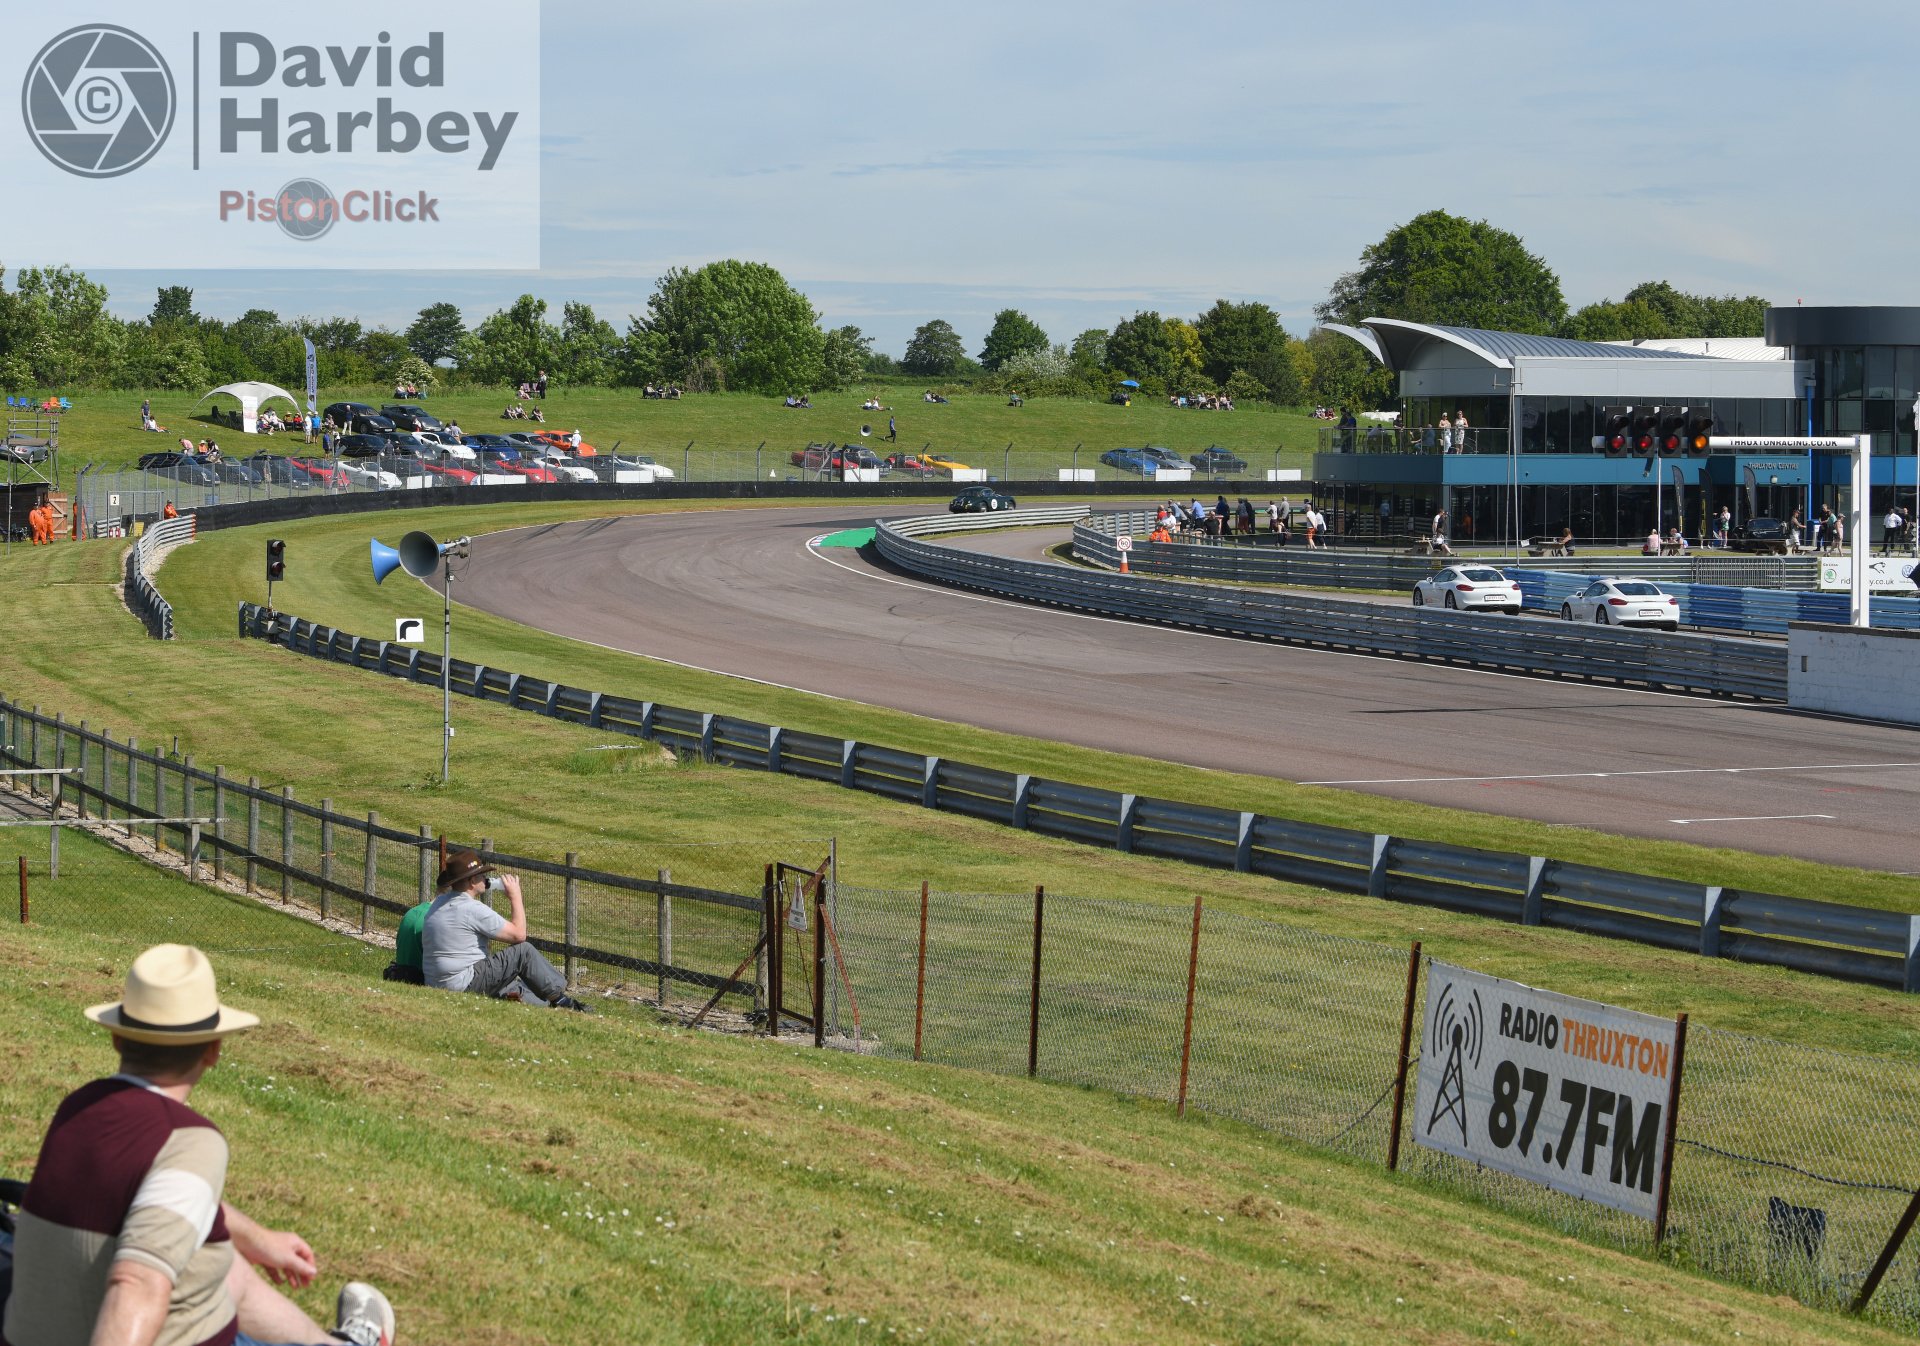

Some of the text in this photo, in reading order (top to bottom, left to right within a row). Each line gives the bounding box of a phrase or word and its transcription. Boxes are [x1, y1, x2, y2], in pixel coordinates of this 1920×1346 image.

[113, 496, 117, 504] 2
[1499, 1002, 1670, 1079] RADIO THRUXTON
[1488, 1060, 1662, 1194] 87.7FM
